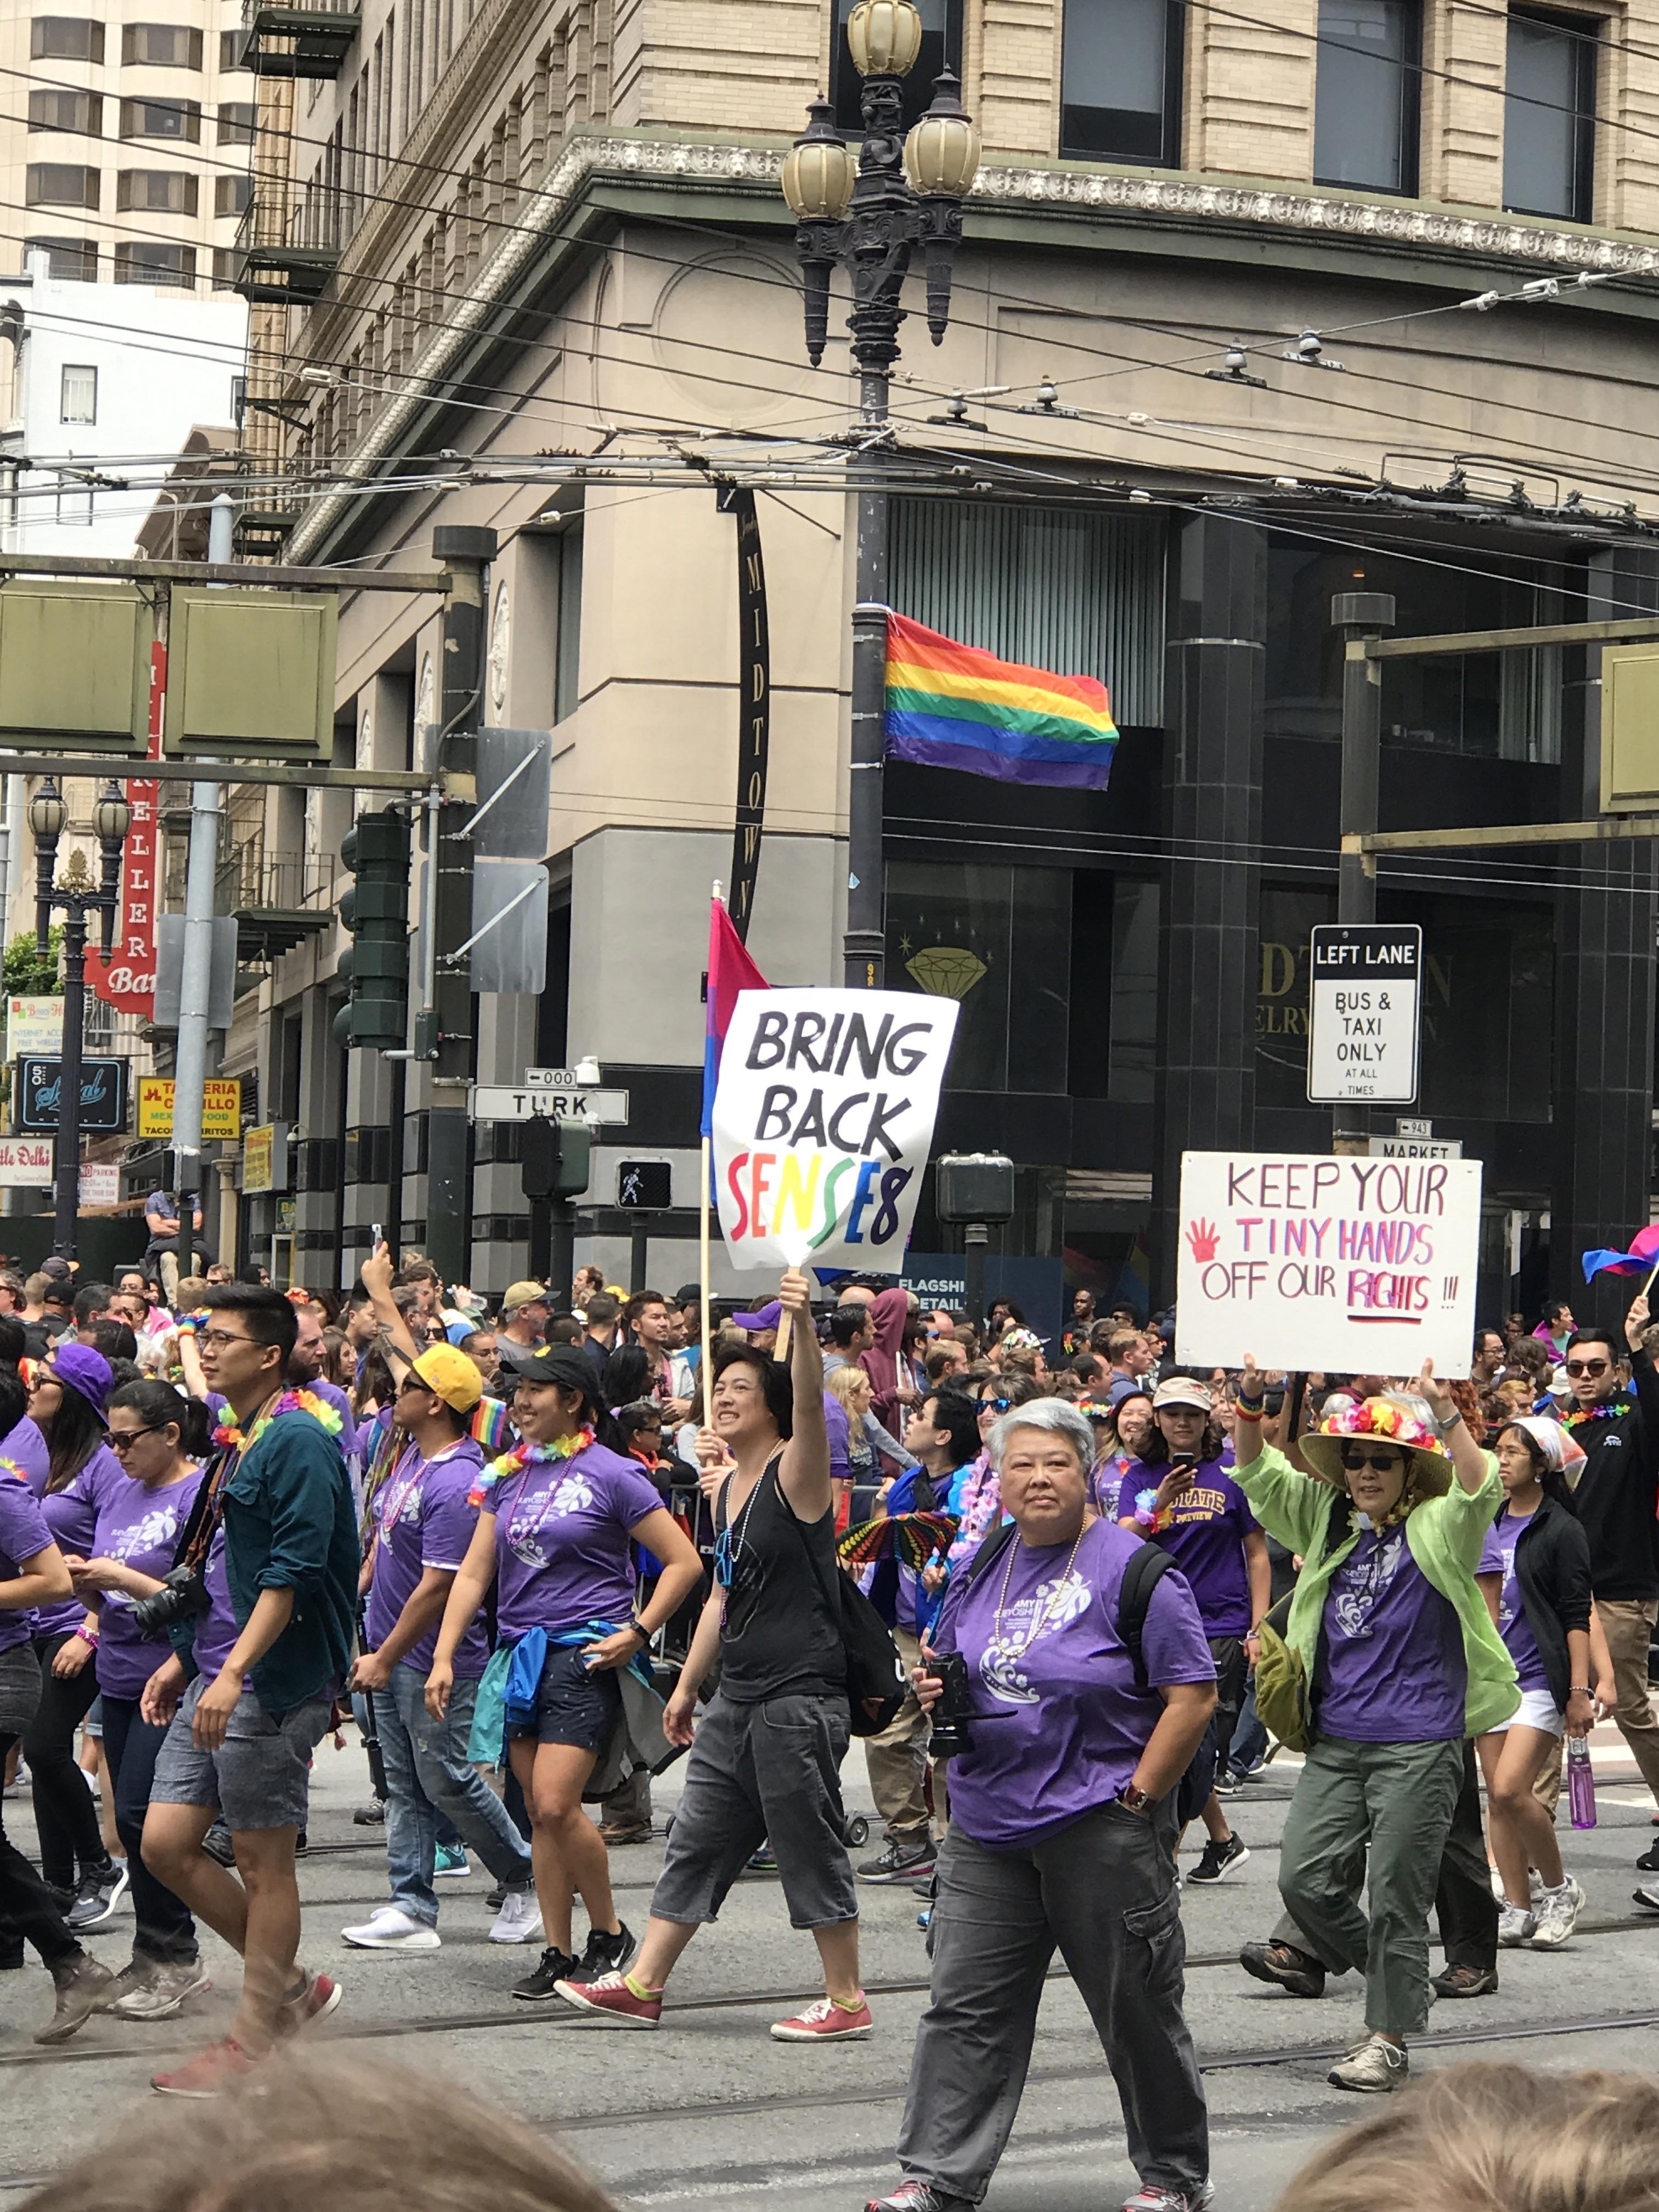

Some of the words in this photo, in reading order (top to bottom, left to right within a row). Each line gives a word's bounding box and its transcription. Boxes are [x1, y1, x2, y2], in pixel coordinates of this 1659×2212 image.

[736, 552, 764, 918] MIDTOWN
[1317, 945, 1360, 964] LEFT
[1365, 945, 1414, 964] LANE
[1335, 992, 1371, 1011] BUS
[1378, 992, 1391, 1011] &
[1342, 1018, 1381, 1036] TAXI
[745, 1011, 934, 1080] BRING
[1337, 1043, 1387, 1062] ONLY
[544, 1072, 572, 1085] 000
[1345, 1069, 1357, 1079] AT
[1359, 1069, 1378, 1079] ALL
[162, 1083, 236, 1095] TERIA
[1347, 1085, 1375, 1095] TIMES
[164, 1098, 235, 1110] CILLO
[513, 1094, 587, 1115] TURK
[754, 1084, 912, 1163] BACK
[16, 1144, 50, 1166] Delhi
[1384, 1143, 1449, 1159] MARKET
[1228, 1162, 1340, 1210] KEEP
[1350, 1163, 1448, 1216] YOUR
[727, 1152, 915, 1250] SENSE8
[1236, 1217, 1332, 1260] TINY
[1338, 1218, 1434, 1265] HANDS
[899, 1279, 964, 1293] FLAGSHI
[1202, 1261, 1269, 1300] OFF
[1278, 1262, 1336, 1298] OUR
[1347, 1268, 1431, 1311] RIGHTS
[919, 1297, 963, 1311] ETAIL
[1176, 1511, 1213, 1524] PREVIEW
[1014, 1599, 1036, 1608] AMY
